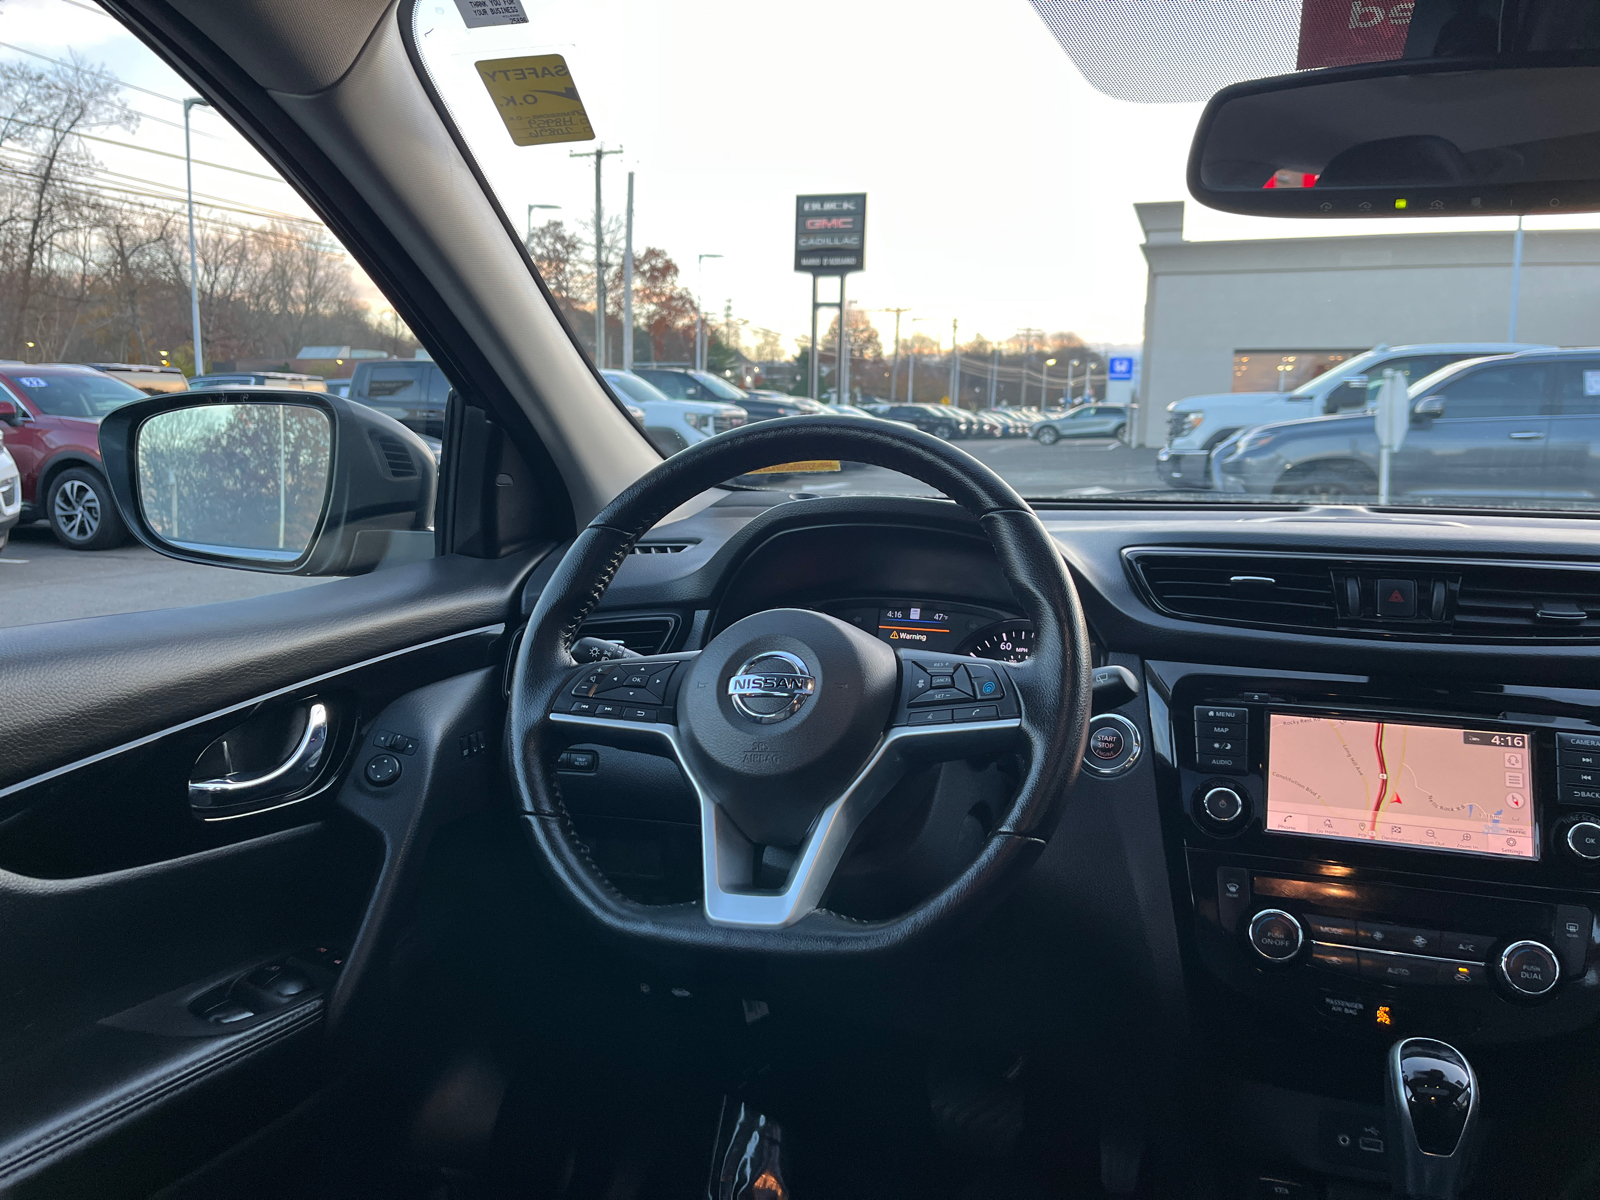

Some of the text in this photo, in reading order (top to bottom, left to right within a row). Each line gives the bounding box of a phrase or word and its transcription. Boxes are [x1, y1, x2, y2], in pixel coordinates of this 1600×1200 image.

[473, 6, 519, 17] YOUR BUSINESS
[804, 200, 856, 211] BUICK
[806, 218, 854, 229] GMC
[798, 236, 859, 246] CADILLAC
[887, 610, 902, 619] 4:16
[899, 632, 927, 642] Warning
[1000, 642, 1012, 651] 60
[734, 677, 804, 690] NISSAN
[932, 676, 951, 684] CANCEL
[1097, 735, 1117, 743] START
[1490, 734, 1524, 747] 4:16
[1570, 738, 1600, 747] CAMERA
[752, 741, 769, 751] SRS
[742, 753, 780, 763] AIRBAG
[1272, 771, 1306, 790] Constitution
[1267, 931, 1285, 939] PUSH
[1319, 926, 1344, 935] MODE
[1457, 943, 1475, 952] A/C
[1520, 972, 1543, 980] DUAL
